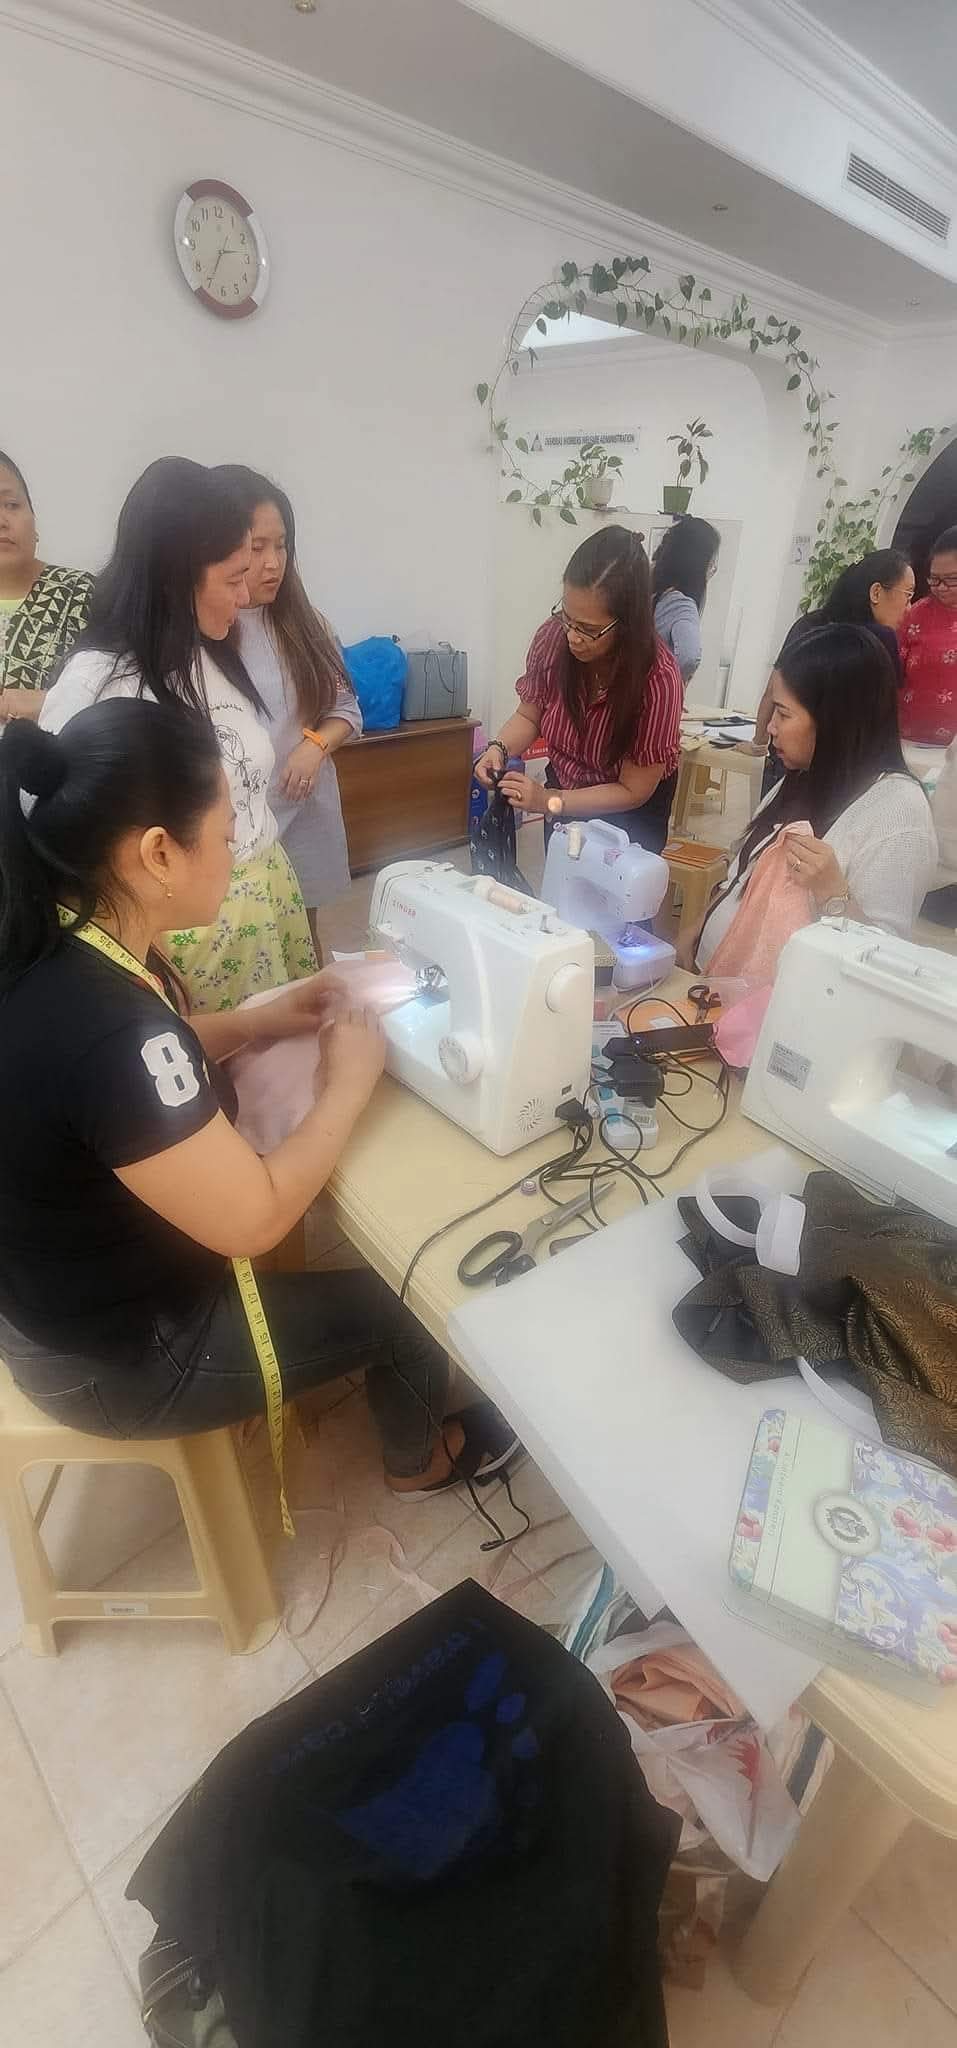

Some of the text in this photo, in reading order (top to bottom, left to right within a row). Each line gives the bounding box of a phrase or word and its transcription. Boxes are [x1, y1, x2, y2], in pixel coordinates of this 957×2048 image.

[201, 207, 209, 221] 11
[213, 205, 224, 219] 12
[191, 219, 201, 233] 10
[240, 233, 246, 245] 2
[244, 254, 250, 265] 3
[195, 260, 202, 272] 8
[207, 277, 216, 289] 7
[242, 272, 248, 284] 4
[220, 286, 227, 297] 6
[233, 283, 240, 295] 5
[141, 1032, 200, 1107] 8
